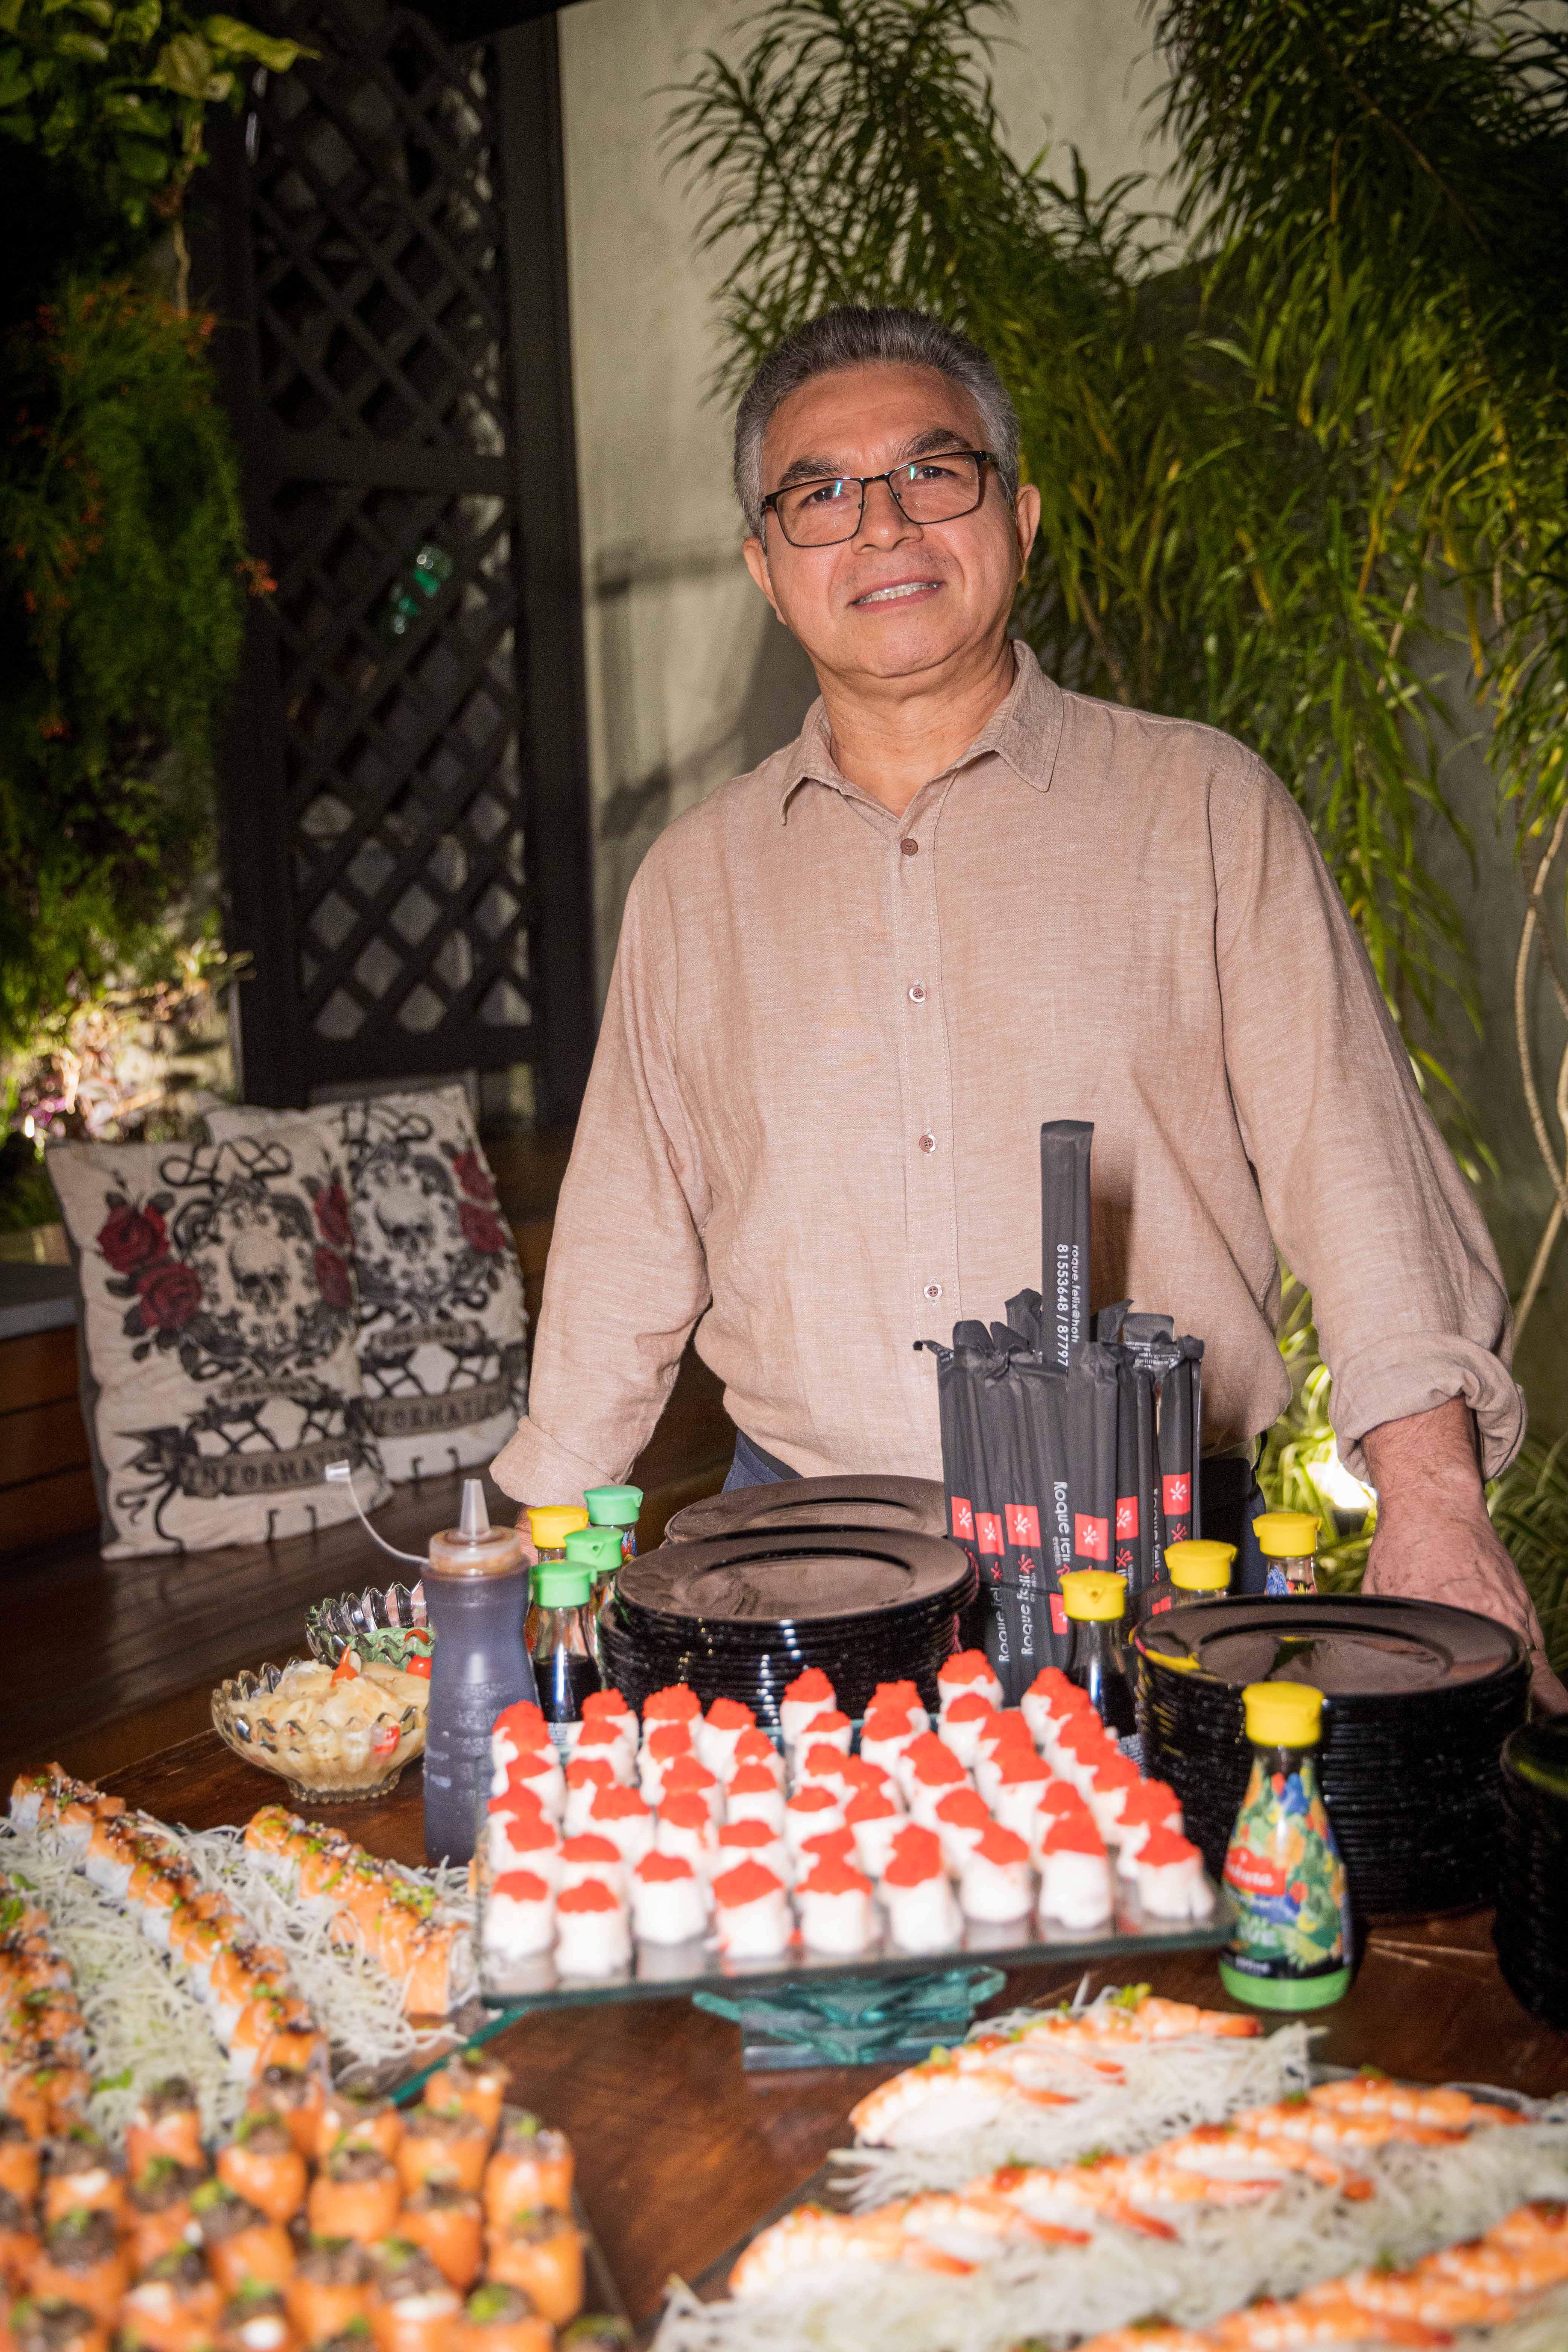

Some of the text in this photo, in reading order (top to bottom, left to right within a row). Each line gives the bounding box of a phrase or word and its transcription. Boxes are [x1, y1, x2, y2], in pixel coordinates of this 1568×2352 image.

[1057, 1244, 1069, 1311] 81553648
[1057, 1325, 1069, 1366] 87797
[1054, 1481, 1070, 1534] Roque
[996, 1611, 1010, 1661] Roque
[1021, 1603, 1034, 1655] Roque
